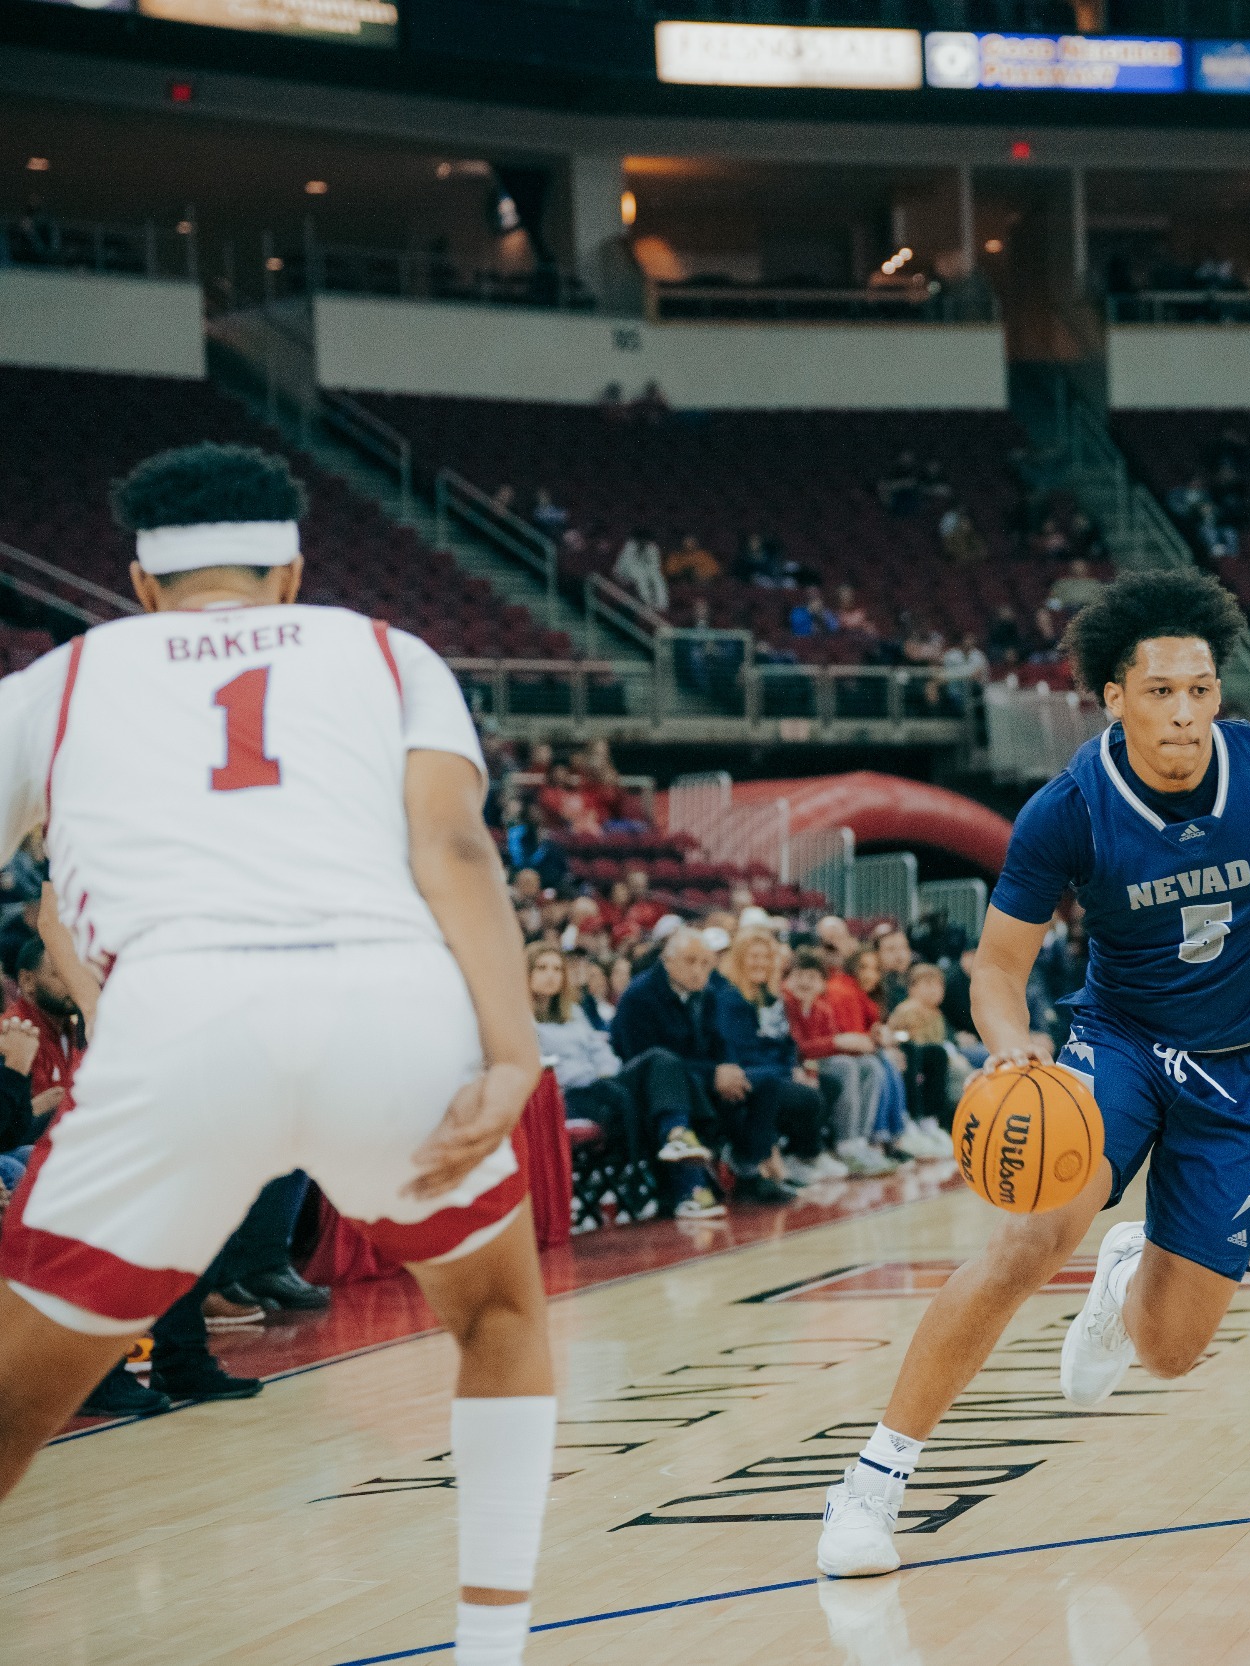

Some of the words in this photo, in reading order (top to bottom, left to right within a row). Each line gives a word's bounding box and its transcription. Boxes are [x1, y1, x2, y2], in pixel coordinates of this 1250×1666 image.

[167, 622, 303, 662] BAKER
[209, 664, 283, 794] 1
[1178, 830, 1206, 842] adidas
[1178, 901, 1232, 964] 5
[999, 1113, 1032, 1204] Wilson
[1227, 1236, 1248, 1248] adidas
